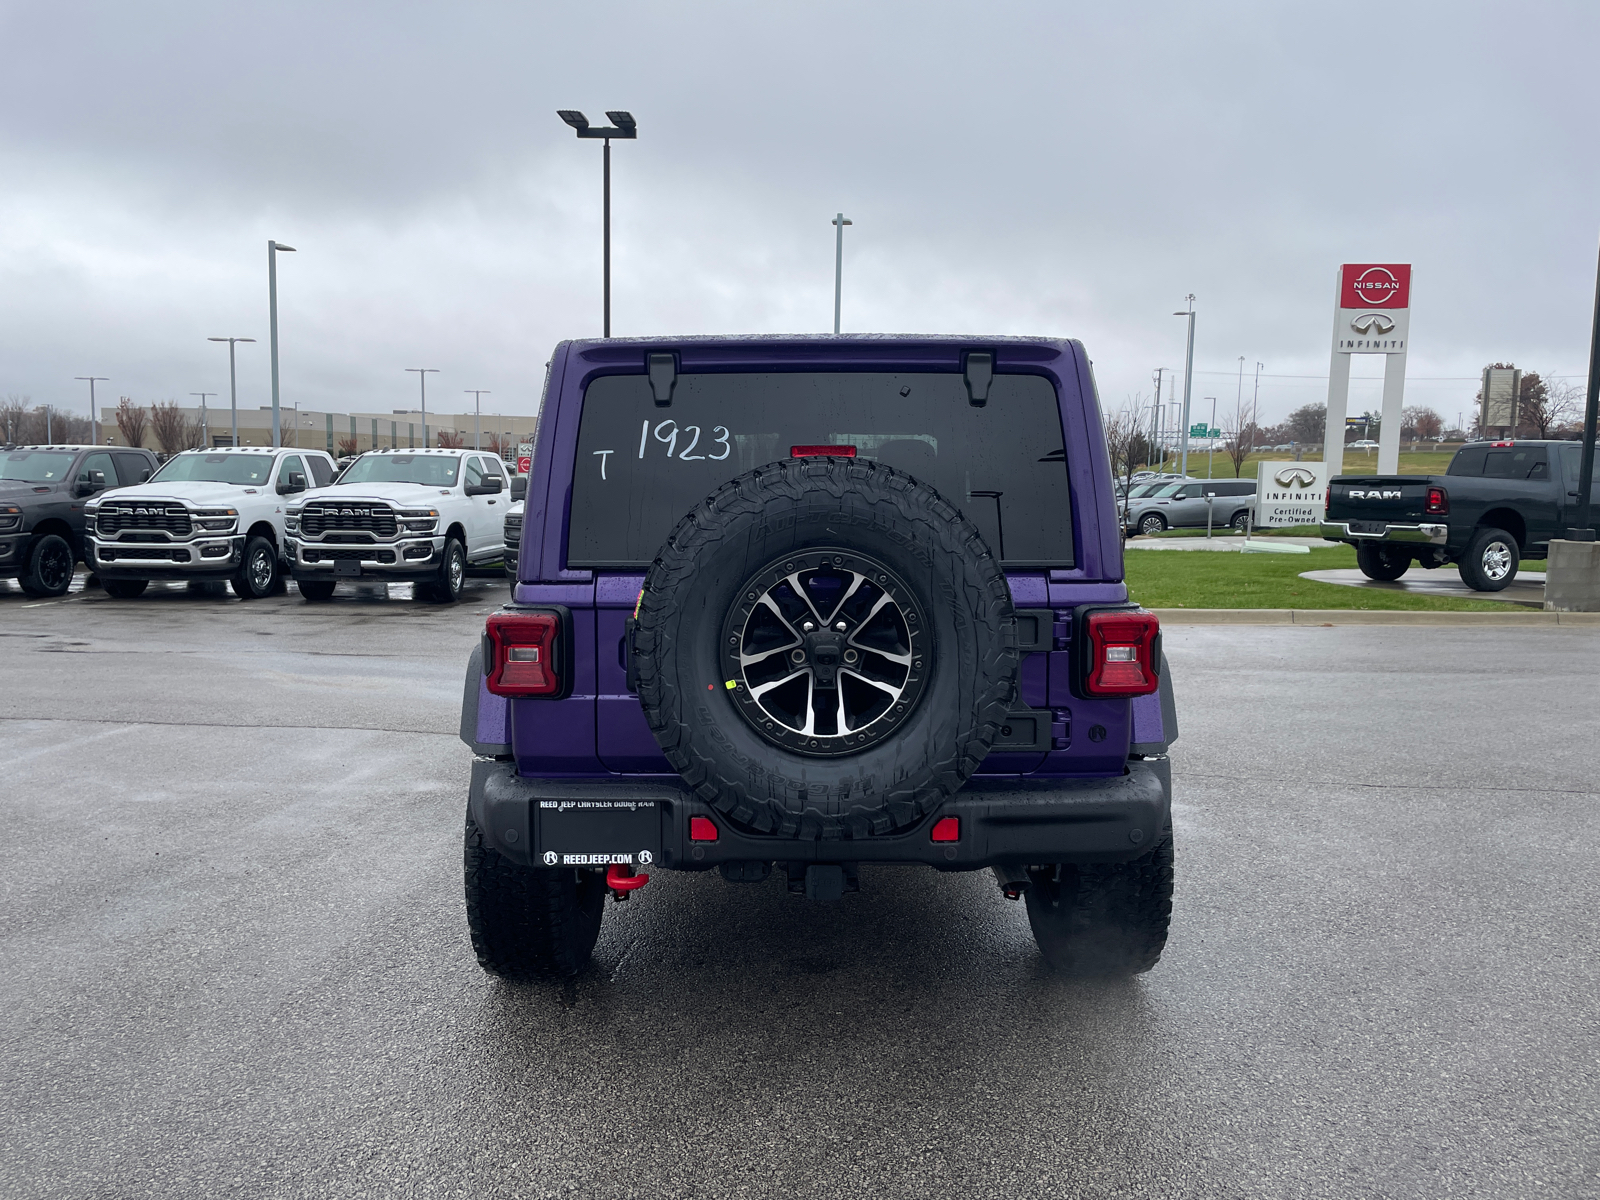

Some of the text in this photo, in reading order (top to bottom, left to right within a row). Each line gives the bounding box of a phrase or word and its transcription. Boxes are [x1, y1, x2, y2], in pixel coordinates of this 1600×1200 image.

[1340, 340, 1404, 348] INFINITI
[593, 419, 731, 480] T 1923
[1266, 493, 1322, 501] INFINITI
[1349, 490, 1402, 500] RAM
[119, 507, 164, 516] RAM
[324, 508, 370, 517] RAM
[1274, 507, 1313, 516] Certified
[540, 801, 558, 809] REED
[563, 854, 633, 865] REEDJEEP.COM
